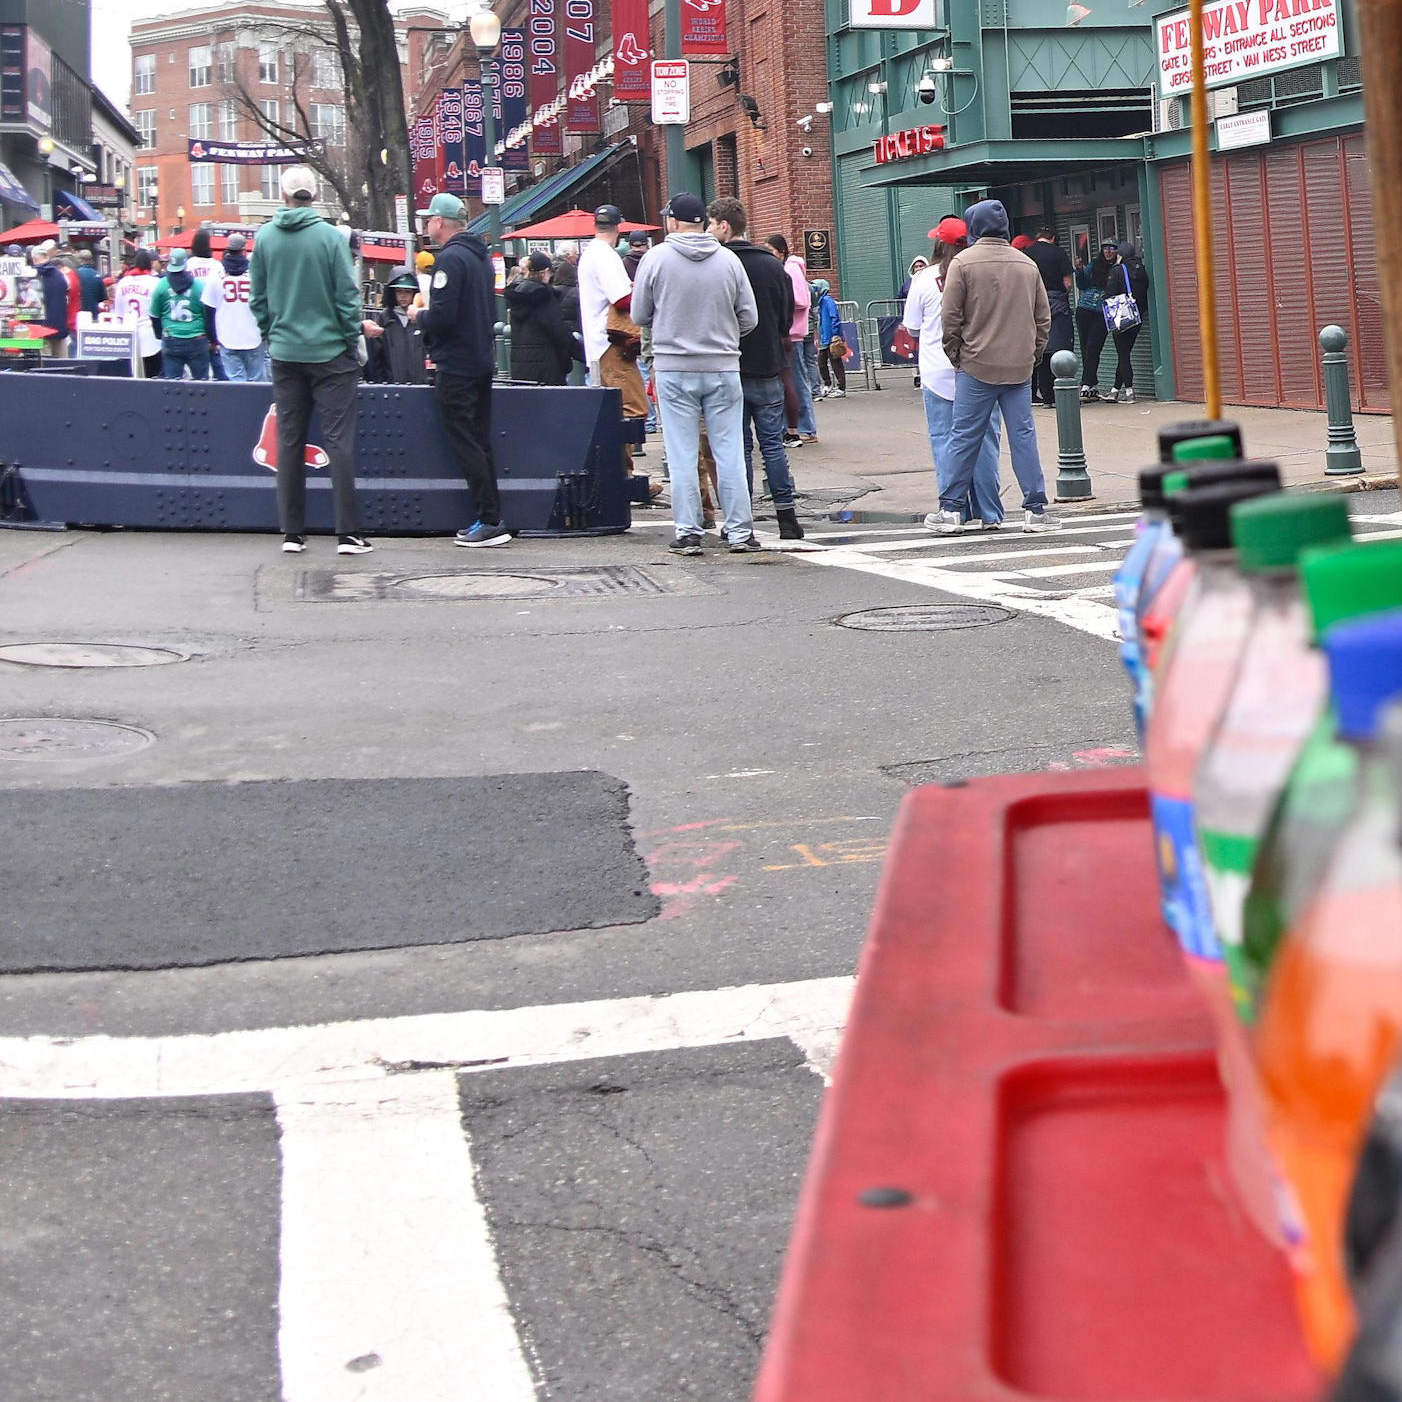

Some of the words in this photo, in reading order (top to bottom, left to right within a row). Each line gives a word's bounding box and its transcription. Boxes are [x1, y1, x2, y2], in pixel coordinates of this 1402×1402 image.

[1162, 55, 1180, 72] GATE
[1182, 54, 1188, 66] D
[1224, 31, 1268, 55] ENTRANCE
[1270, 26, 1287, 42] ALL
[1289, 12, 1336, 37] SECTIONS
[1203, 59, 1233, 79] STREET
[1242, 52, 1260, 68] VAN
[1262, 46, 1287, 63] NESS
[1290, 34, 1328, 57] STREET
[501, 30, 525, 99] 1986
[664, 80, 677, 88] NO
[443, 91, 463, 144] 1946
[463, 83, 484, 137] 1967
[418, 117, 436, 159] 1915
[872, 125, 934, 165] TICKETS
[0, 261, 22, 276] AMS
[128, 298, 142, 318] 3
[168, 299, 193, 323] 16
[222, 279, 252, 304] 35
[84, 336, 101, 346] BAG
[102, 336, 130, 346] POLICY
